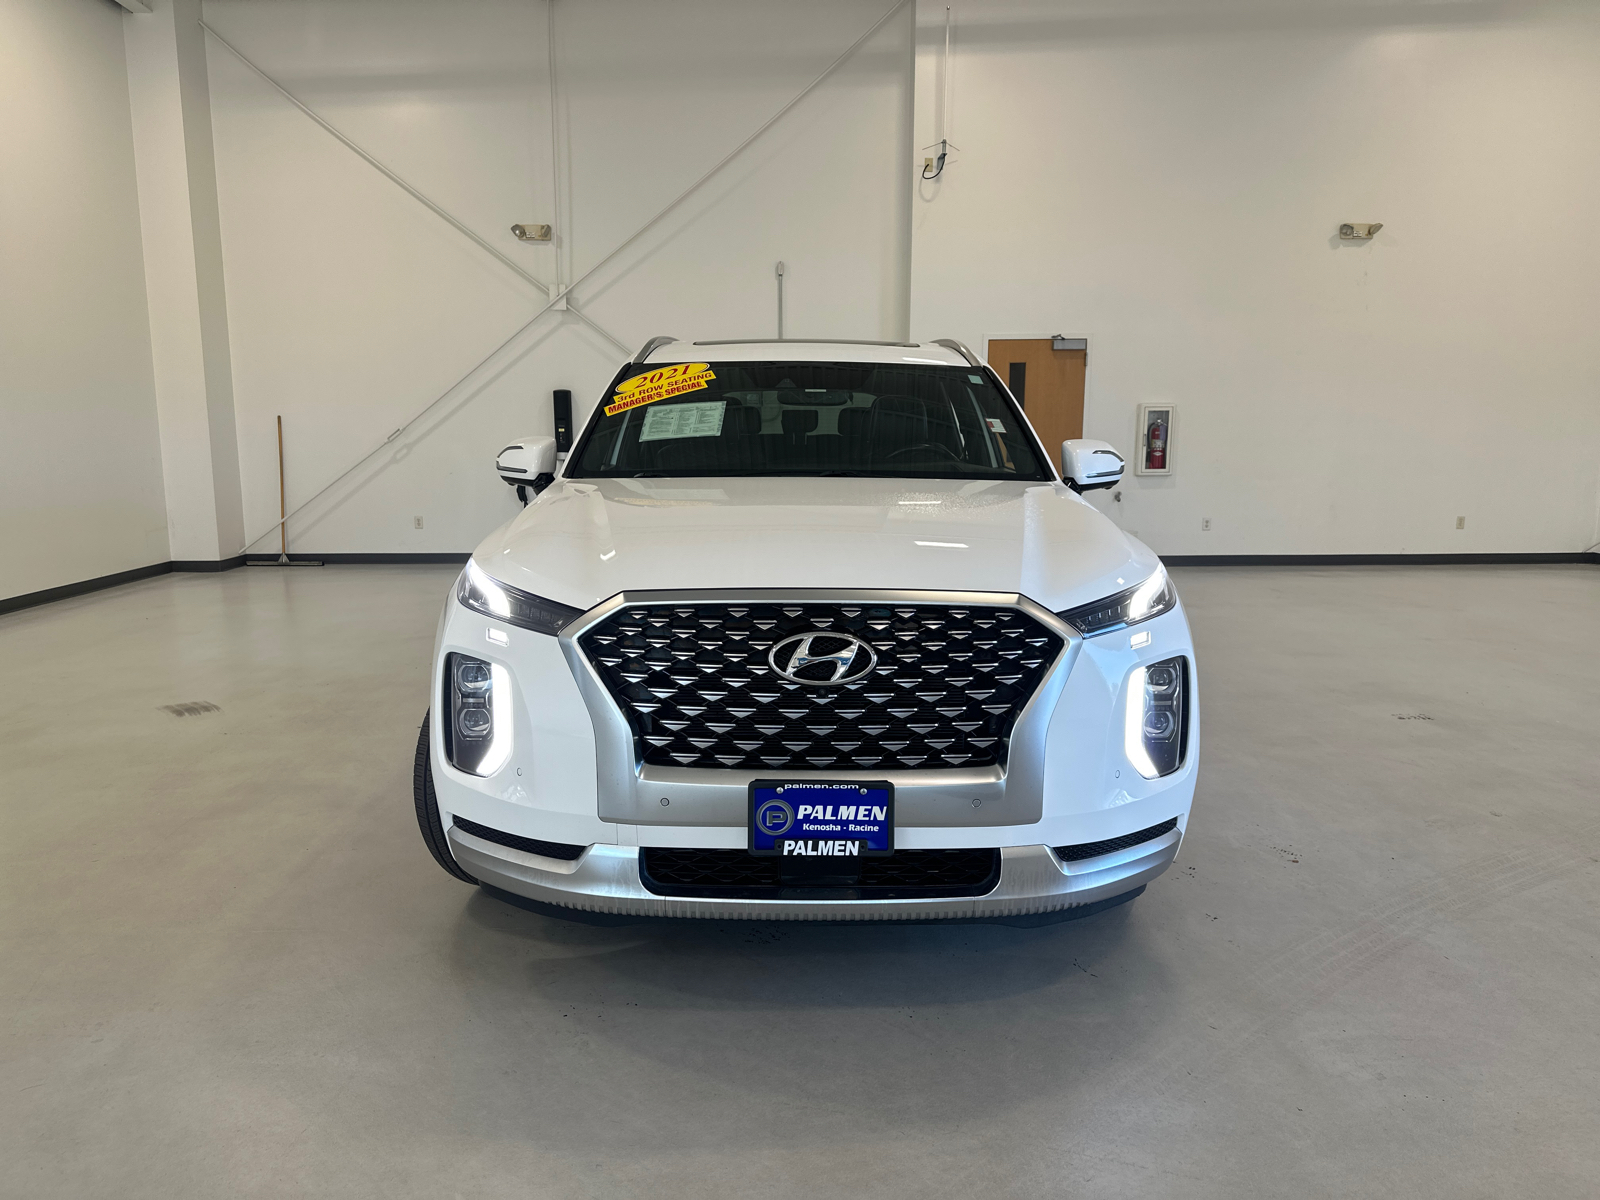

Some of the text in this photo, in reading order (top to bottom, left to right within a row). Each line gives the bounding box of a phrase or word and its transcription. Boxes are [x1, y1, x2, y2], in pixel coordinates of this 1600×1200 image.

[634, 364, 690, 389] 2021
[617, 372, 712, 403] 3rd ROW SEATING
[608, 391, 663, 414] MANAGER'S
[797, 805, 887, 821] PALMEN
[803, 823, 841, 831] Kenosha
[848, 824, 879, 832] Racine
[783, 840, 859, 856] PALMEN
